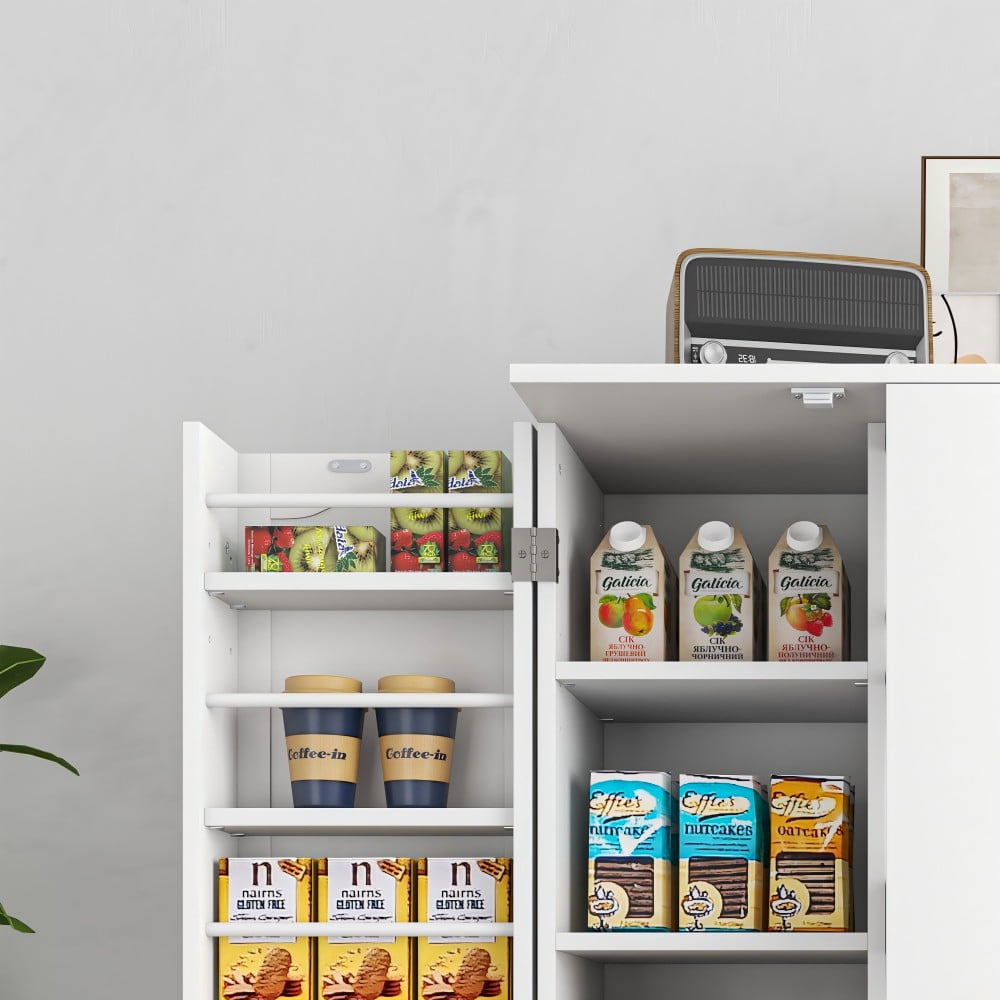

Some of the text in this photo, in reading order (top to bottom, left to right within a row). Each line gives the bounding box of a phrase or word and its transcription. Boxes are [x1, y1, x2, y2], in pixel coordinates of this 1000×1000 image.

[602, 576, 652, 591] Galicia
[692, 577, 744, 592] Galicia
[780, 576, 832, 591] Galicia
[288, 748, 347, 761] Coffee-in
[386, 748, 447, 761] Coffee-in
[685, 822, 753, 836] nutcakes
[252, 862, 272, 886] n
[351, 862, 372, 886] n
[451, 862, 472, 886] n
[242, 890, 282, 898] nairns
[342, 890, 382, 898] nairns
[441, 890, 482, 898] nairns
[237, 900, 286, 910] GLUTEN FREE
[336, 900, 384, 910] GLUTEN FREE
[436, 900, 484, 910] GLUTEN FREE
